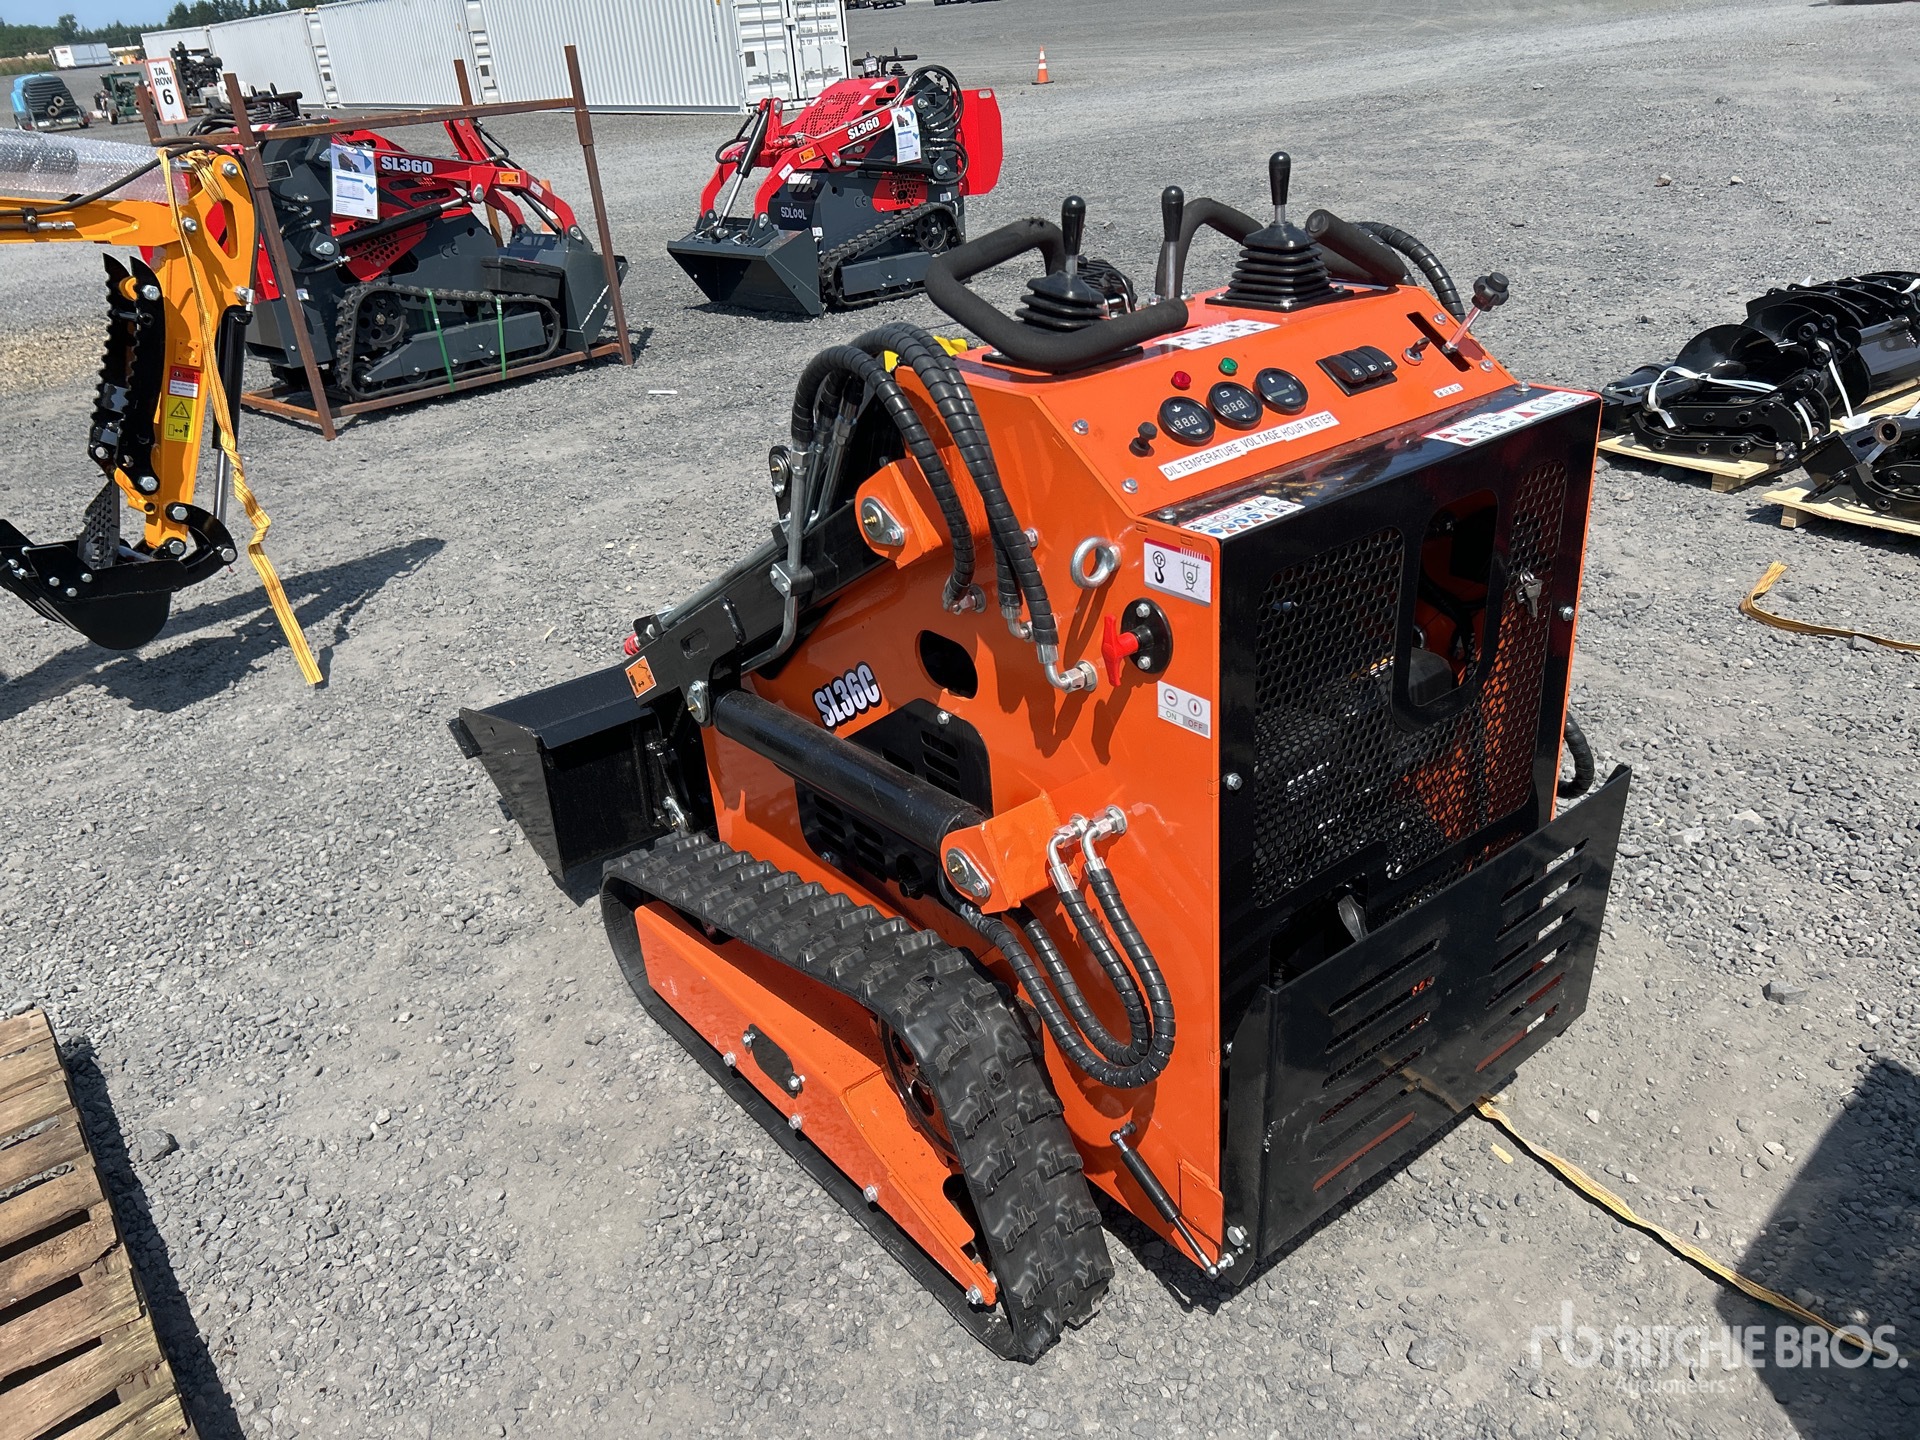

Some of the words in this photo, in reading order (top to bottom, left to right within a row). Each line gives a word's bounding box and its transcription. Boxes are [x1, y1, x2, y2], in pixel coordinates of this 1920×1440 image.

[153, 67, 168, 76] TAL
[154, 76, 172, 86] ROW
[162, 88, 174, 105] 6
[847, 116, 880, 140] SL360
[380, 155, 434, 175] SL360
[1163, 463, 1180, 477] OIL
[1179, 443, 1241, 471] TEMPERATURE
[1242, 429, 1281, 449] VOLTAGE
[1280, 421, 1306, 438] HOUR
[1307, 413, 1335, 430] METER
[1166, 710, 1177, 720] ON
[1188, 720, 1203, 730] OFF
